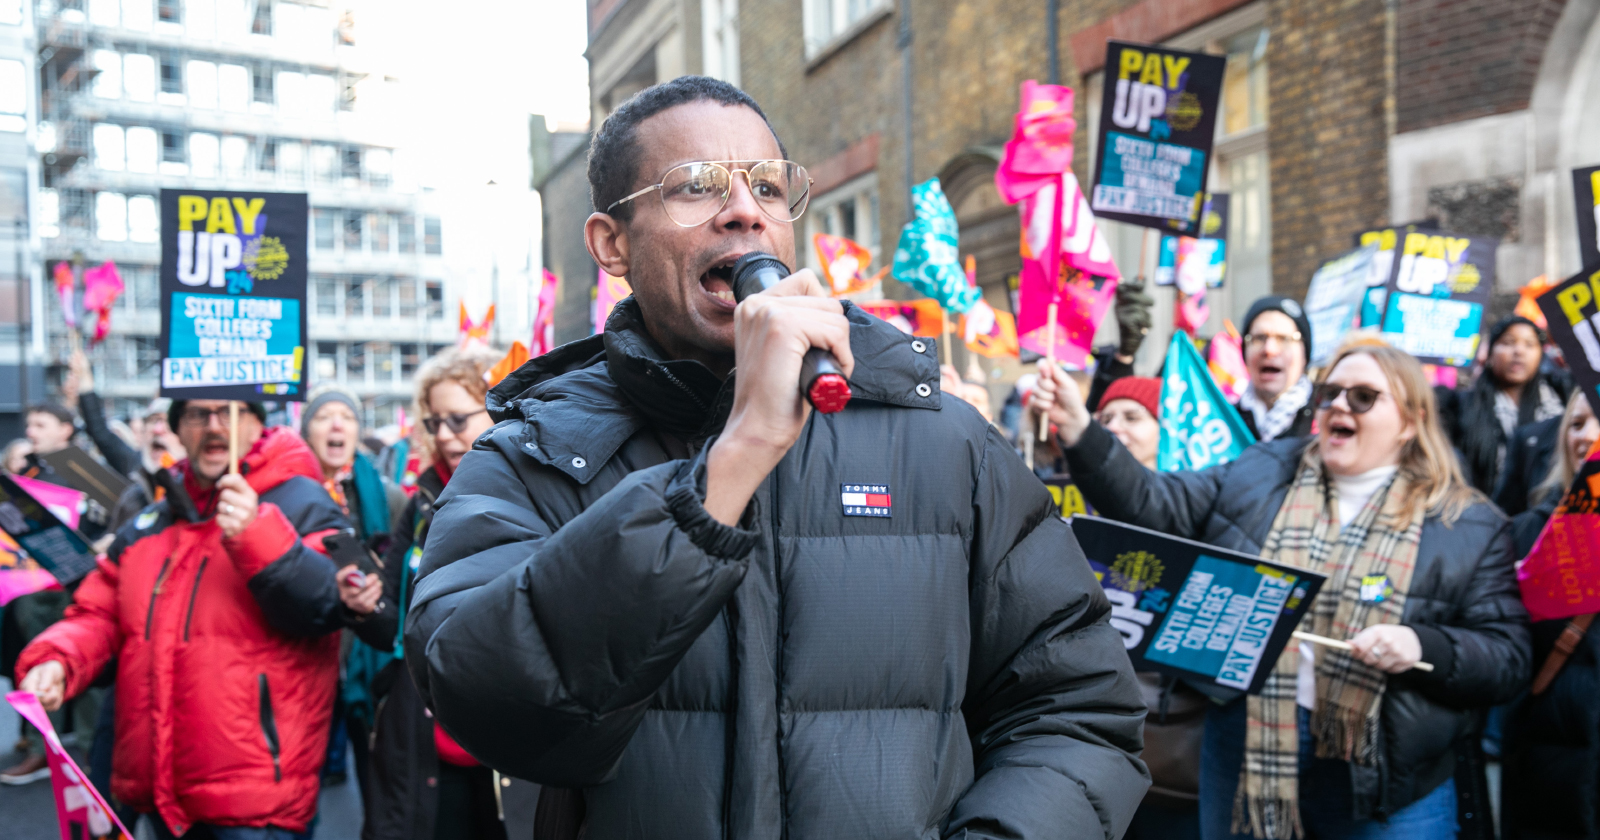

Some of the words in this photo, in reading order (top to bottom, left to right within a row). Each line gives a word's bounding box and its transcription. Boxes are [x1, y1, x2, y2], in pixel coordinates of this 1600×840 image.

[1118, 48, 1192, 91] PAY
[1112, 78, 1167, 133] UP
[178, 195, 266, 236] PAY
[177, 230, 243, 288] UP
[1402, 233, 1471, 264] PAY
[225, 270, 254, 294] 24
[1396, 254, 1449, 295] UP
[184, 296, 235, 319] SIXTH
[238, 298, 283, 320] FORM
[193, 317, 273, 340] COLLEGES
[199, 337, 268, 357] DEMAND
[170, 361, 205, 381] PAY
[845, 485, 887, 493] TOMMY
[1046, 484, 1099, 519] PA
[846, 507, 888, 515] JEANS
[1139, 588, 1171, 613] 24
[1154, 610, 1194, 654] SIXTH
[1177, 570, 1215, 610] FORM
[1181, 584, 1234, 651] COLLEGES
[1205, 594, 1256, 652] DEMAND
[1221, 650, 1255, 683] PAY
